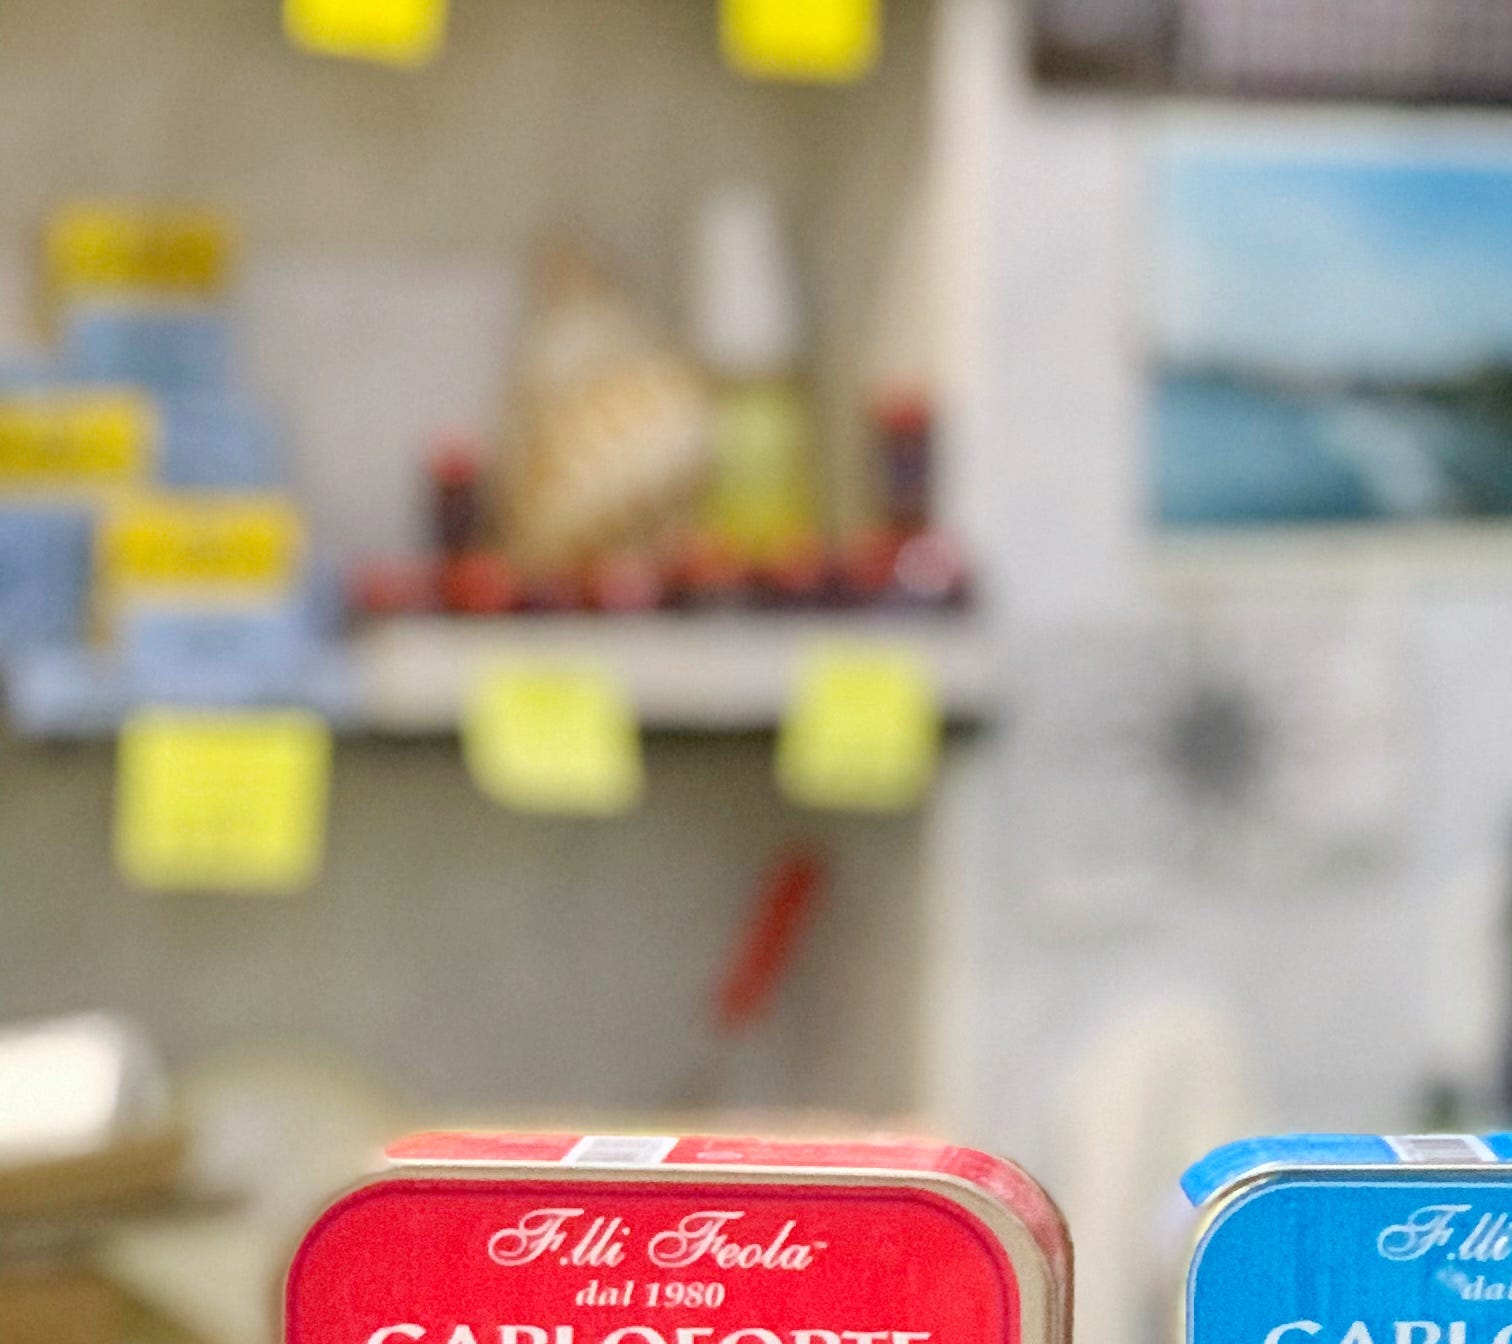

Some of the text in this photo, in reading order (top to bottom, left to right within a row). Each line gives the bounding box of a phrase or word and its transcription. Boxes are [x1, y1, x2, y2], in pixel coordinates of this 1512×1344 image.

[647, 1208, 815, 1272] Feola
[575, 1280, 726, 1309] dal 1980
